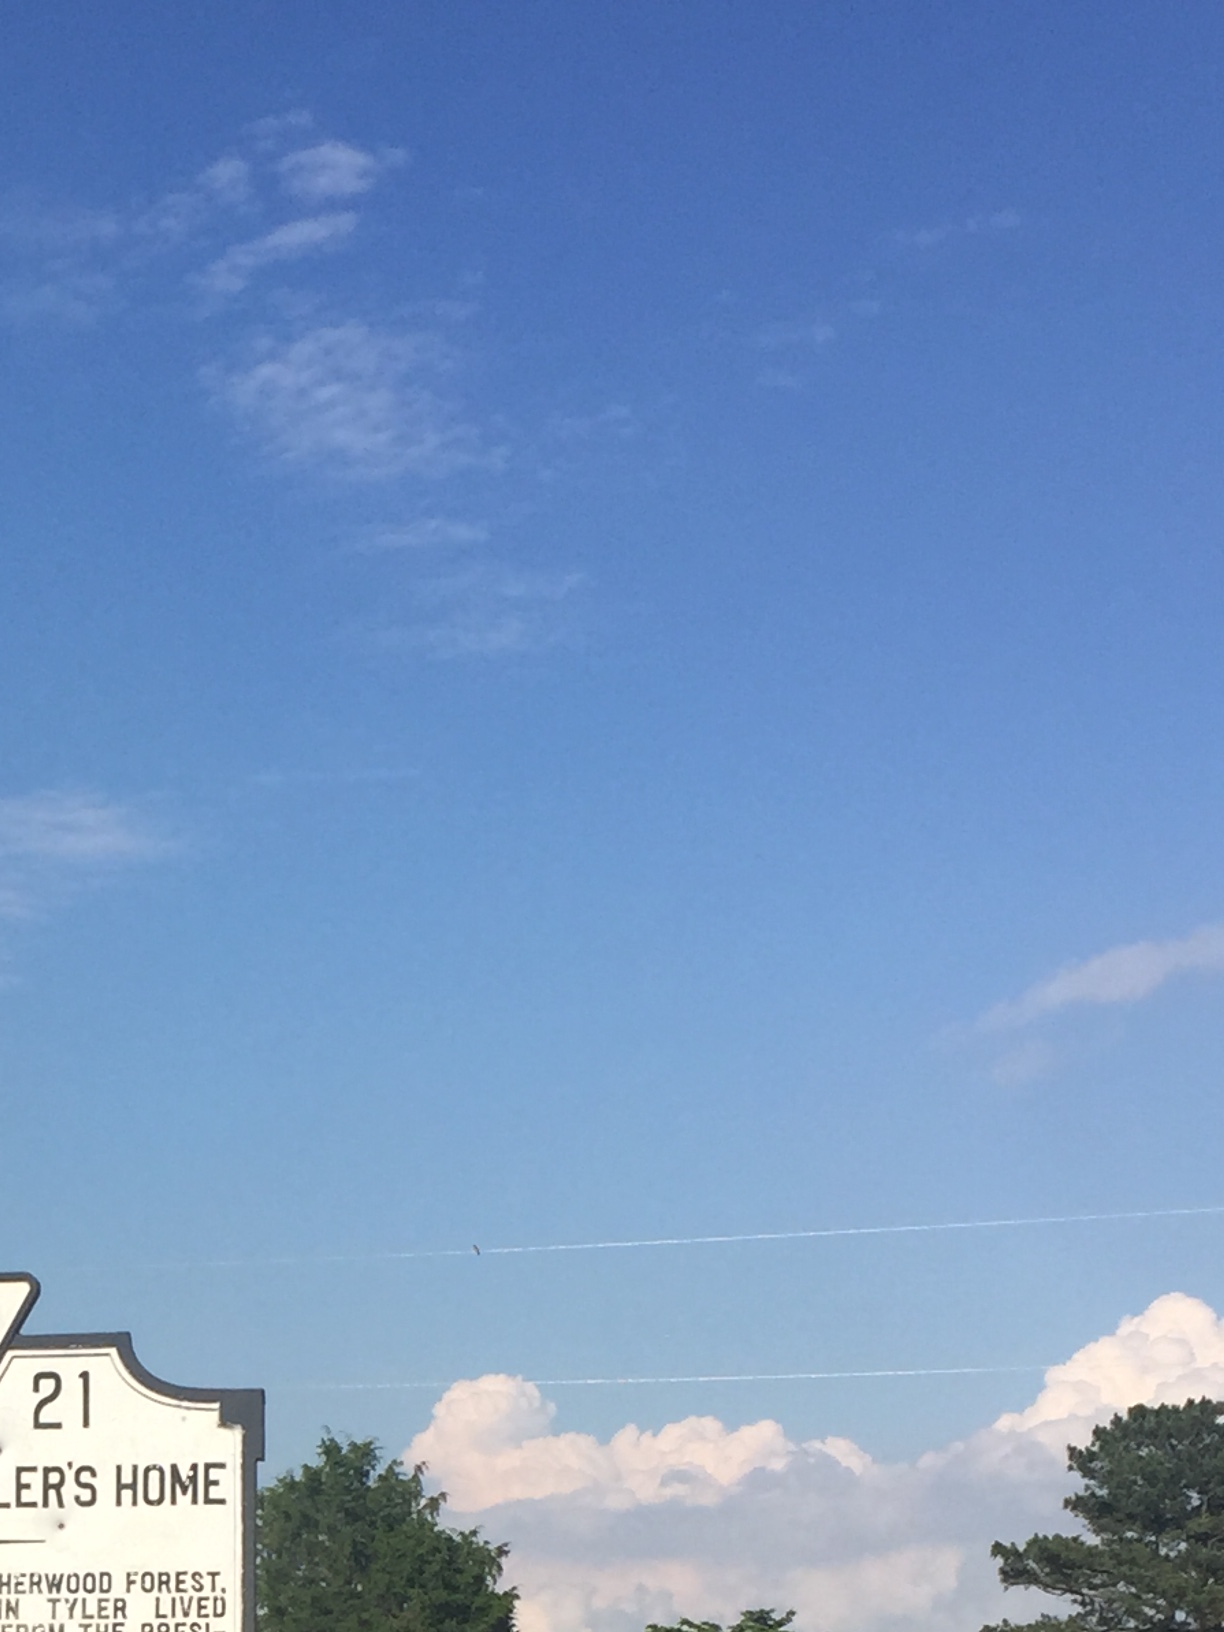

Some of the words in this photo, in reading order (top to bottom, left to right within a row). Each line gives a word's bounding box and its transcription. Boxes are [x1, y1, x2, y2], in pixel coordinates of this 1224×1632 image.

[32, 1370, 91, 1431] 21
[115, 1462, 227, 1507] HOME
[125, 1571, 227, 1594] FOREST,
[46, 1598, 128, 1620] TYLER
[154, 1596, 227, 1619] LIVED
